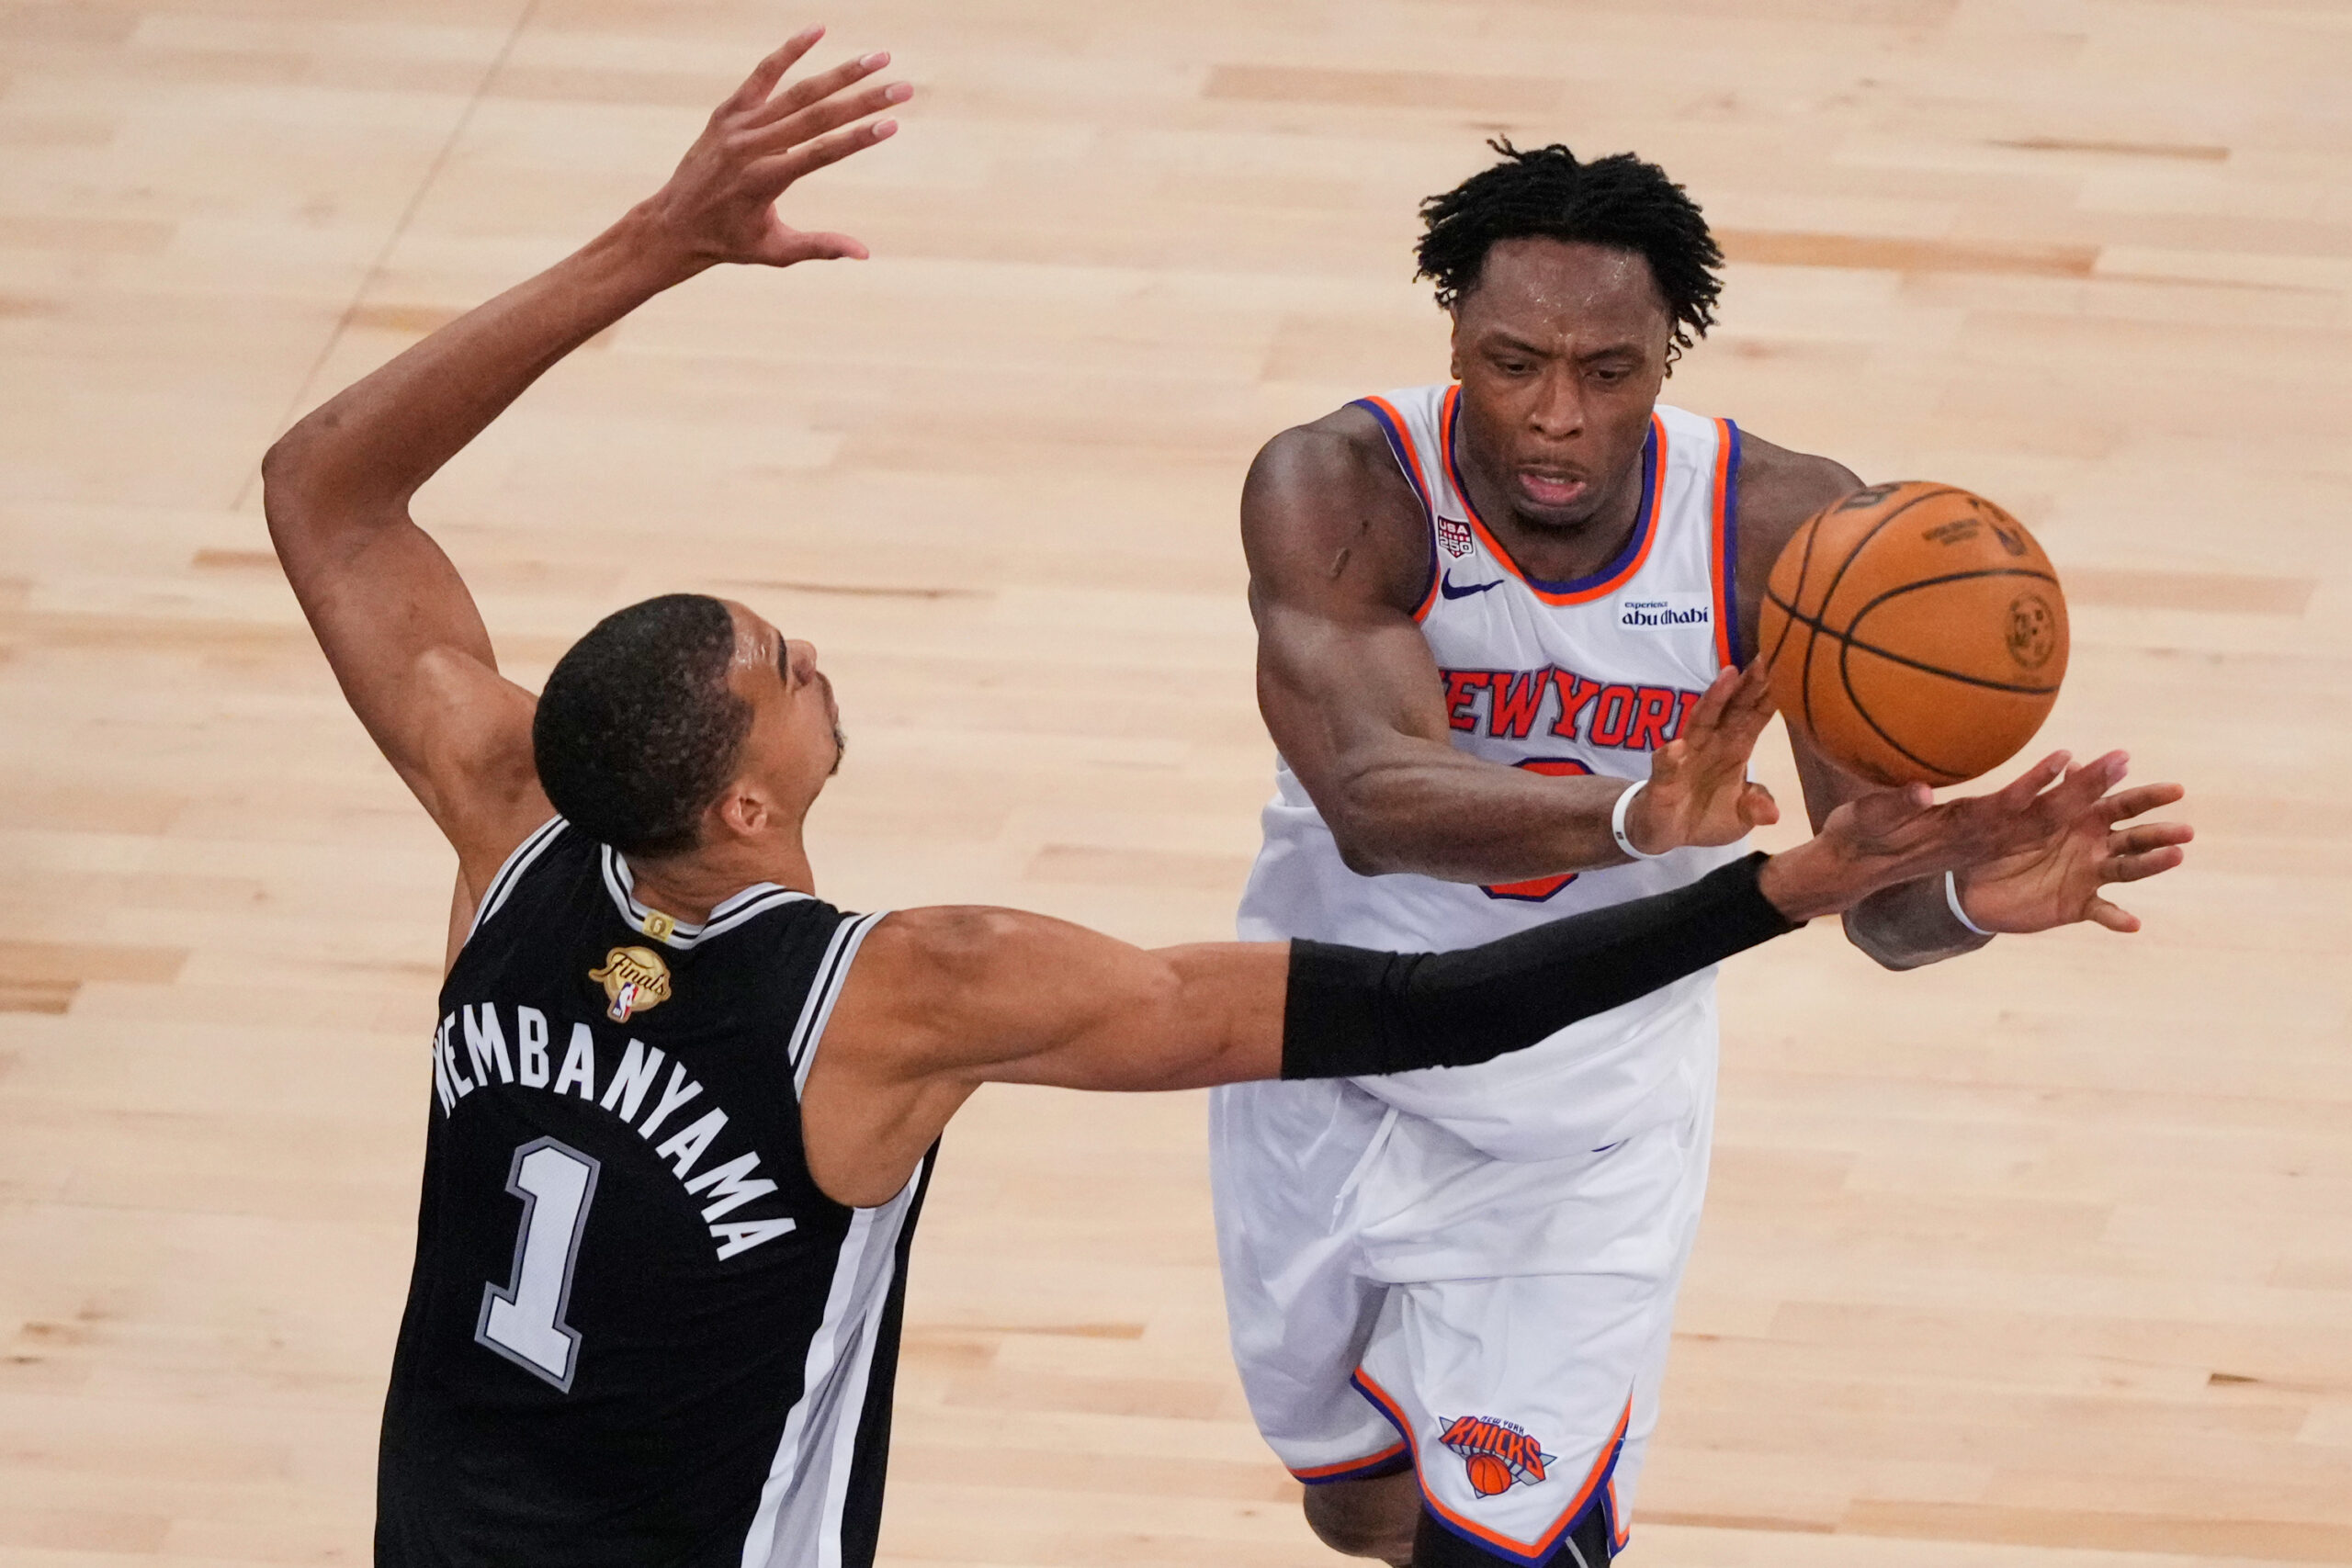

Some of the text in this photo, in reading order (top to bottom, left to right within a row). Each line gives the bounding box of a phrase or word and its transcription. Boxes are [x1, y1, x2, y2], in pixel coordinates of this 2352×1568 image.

[1439, 520, 1468, 535] USA
[1440, 536, 1473, 554] 250
[1624, 601, 1668, 609] experience
[1622, 610, 1657, 626] abu
[1439, 663, 1553, 740] EW
[600, 952, 670, 997] Finals
[475, 1134, 601, 1394] 1
[1480, 1416, 1525, 1435] NEW YORK
[1440, 1416, 1546, 1482] KNICKS
